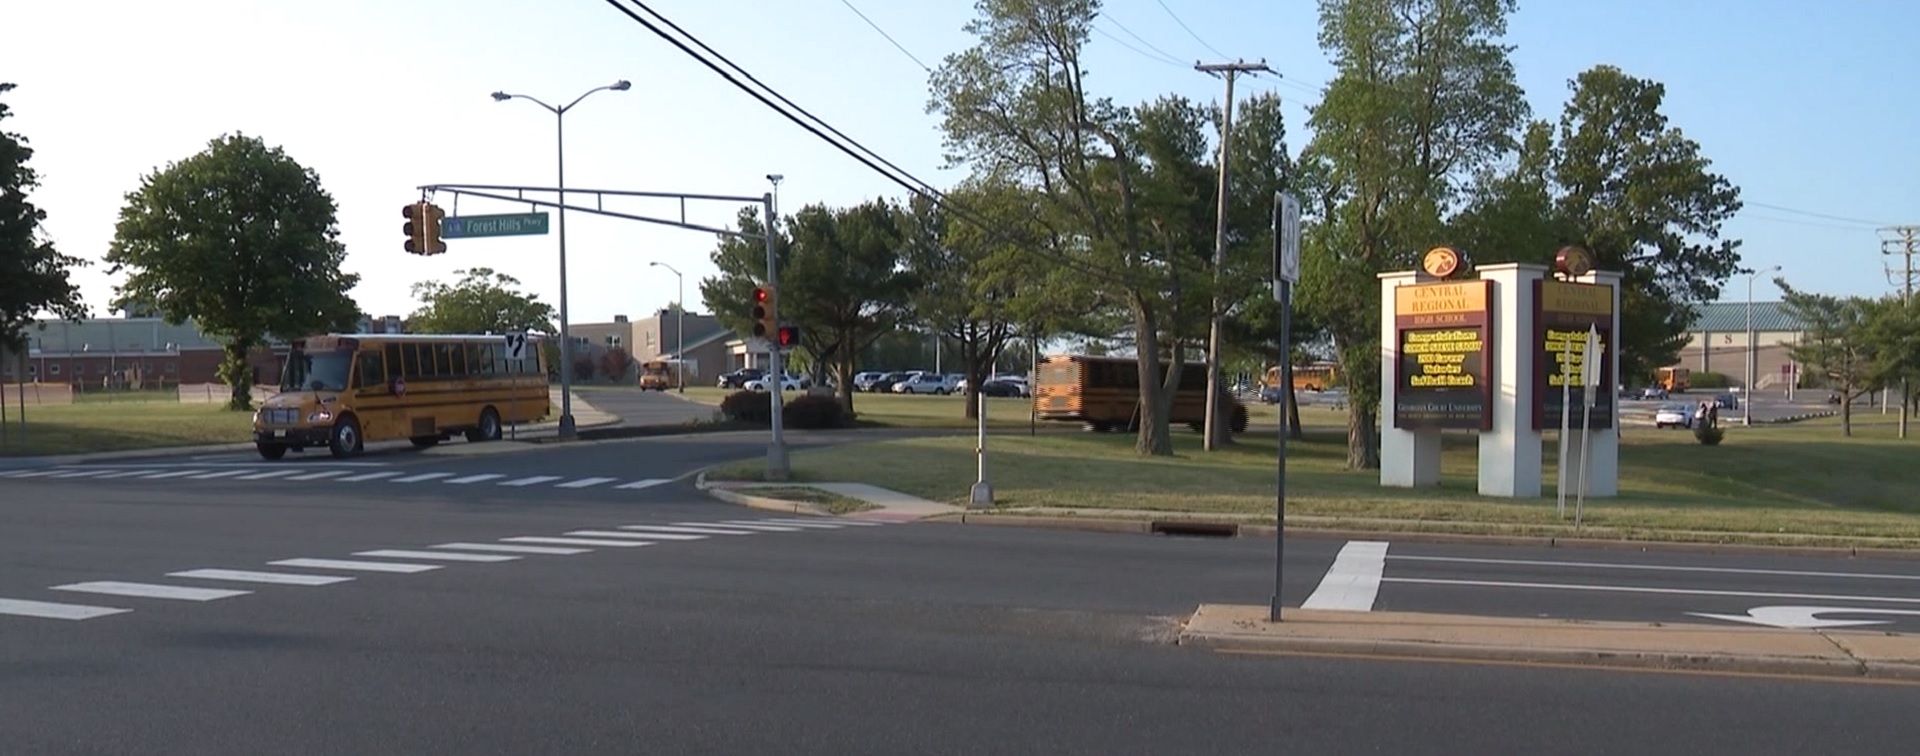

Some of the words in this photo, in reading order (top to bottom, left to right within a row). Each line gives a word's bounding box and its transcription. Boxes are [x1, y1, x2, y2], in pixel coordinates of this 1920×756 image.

[467, 220, 497, 233] Forest
[499, 218, 521, 232] Hills
[1414, 285, 1467, 299] CENTRAL
[1412, 299, 1470, 312] REGIONAL
[1435, 313, 1467, 323] SCHOOL
[1408, 331, 1477, 342] Congratulations
